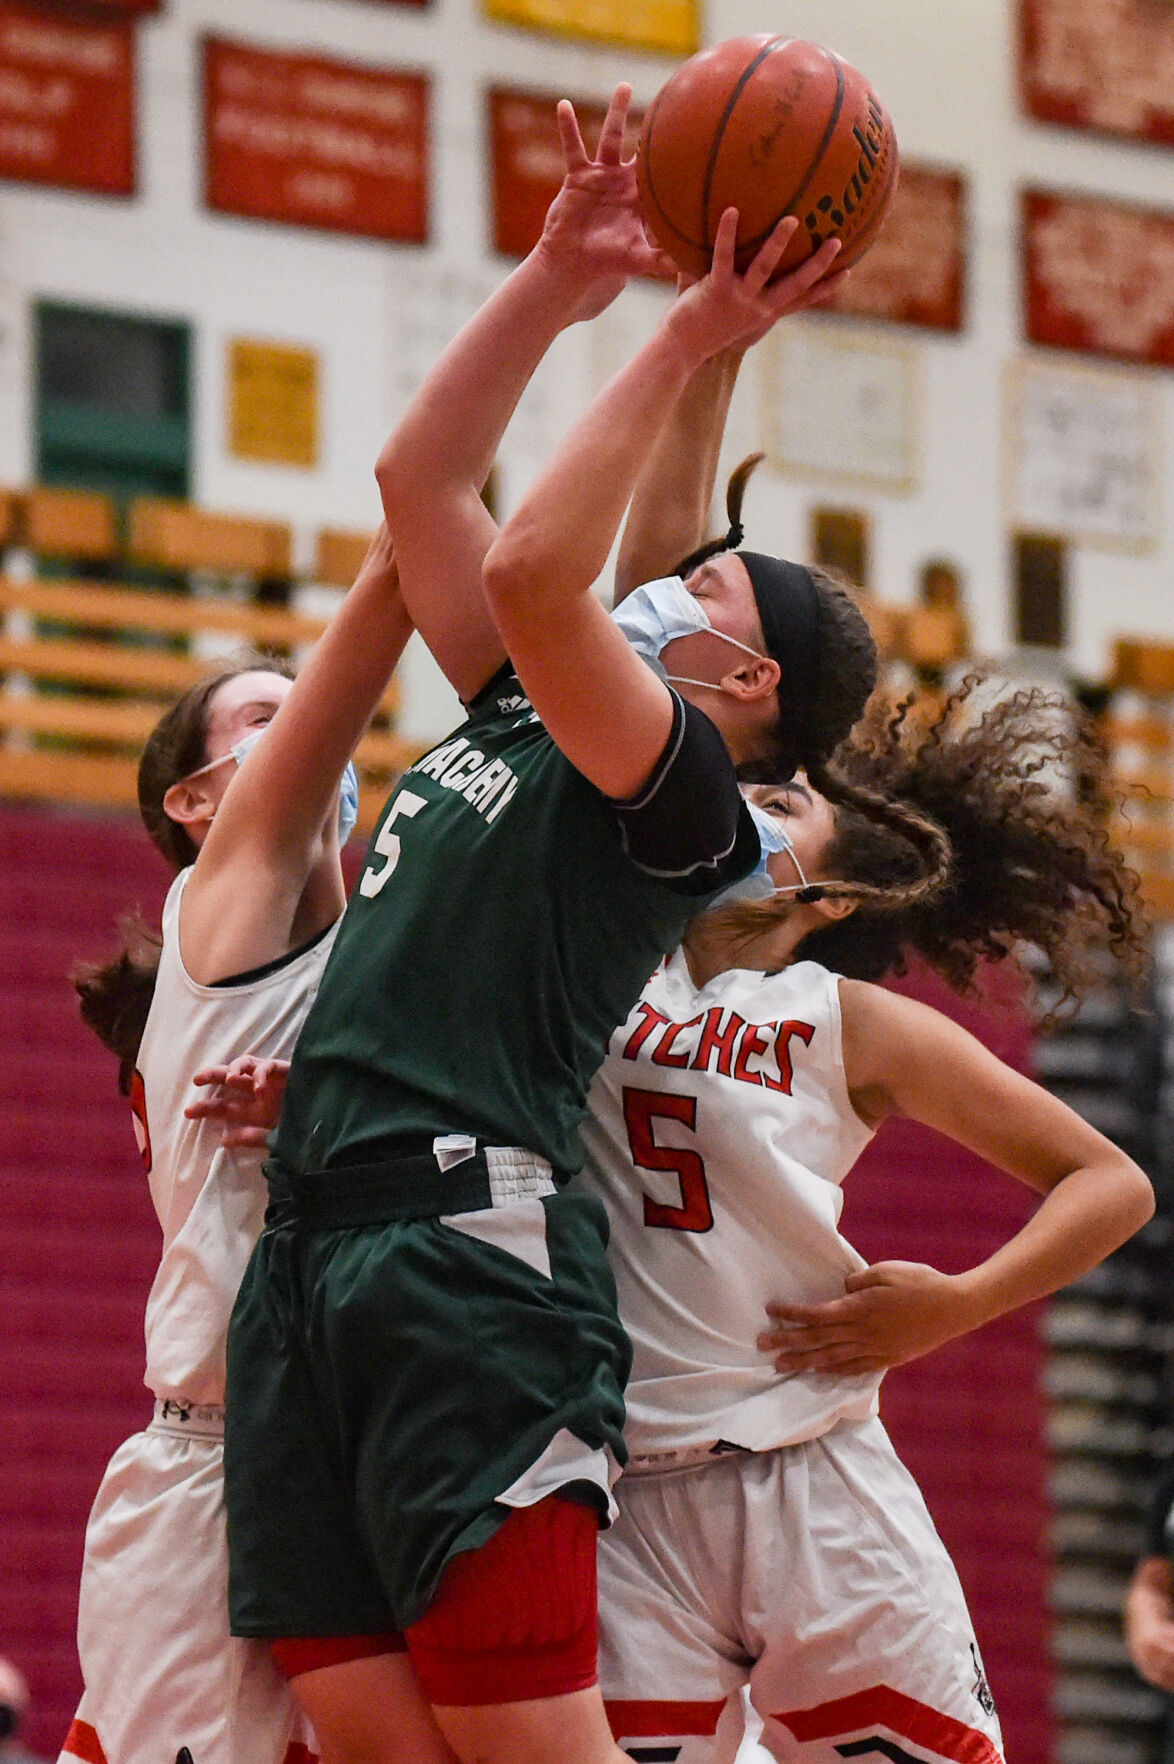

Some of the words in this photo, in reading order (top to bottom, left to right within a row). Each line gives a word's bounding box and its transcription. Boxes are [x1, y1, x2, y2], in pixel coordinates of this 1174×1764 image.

[804, 96, 883, 251] Baden
[359, 789, 429, 899] 5
[603, 1001, 816, 1097] TCHES
[622, 1086, 715, 1233] 5
